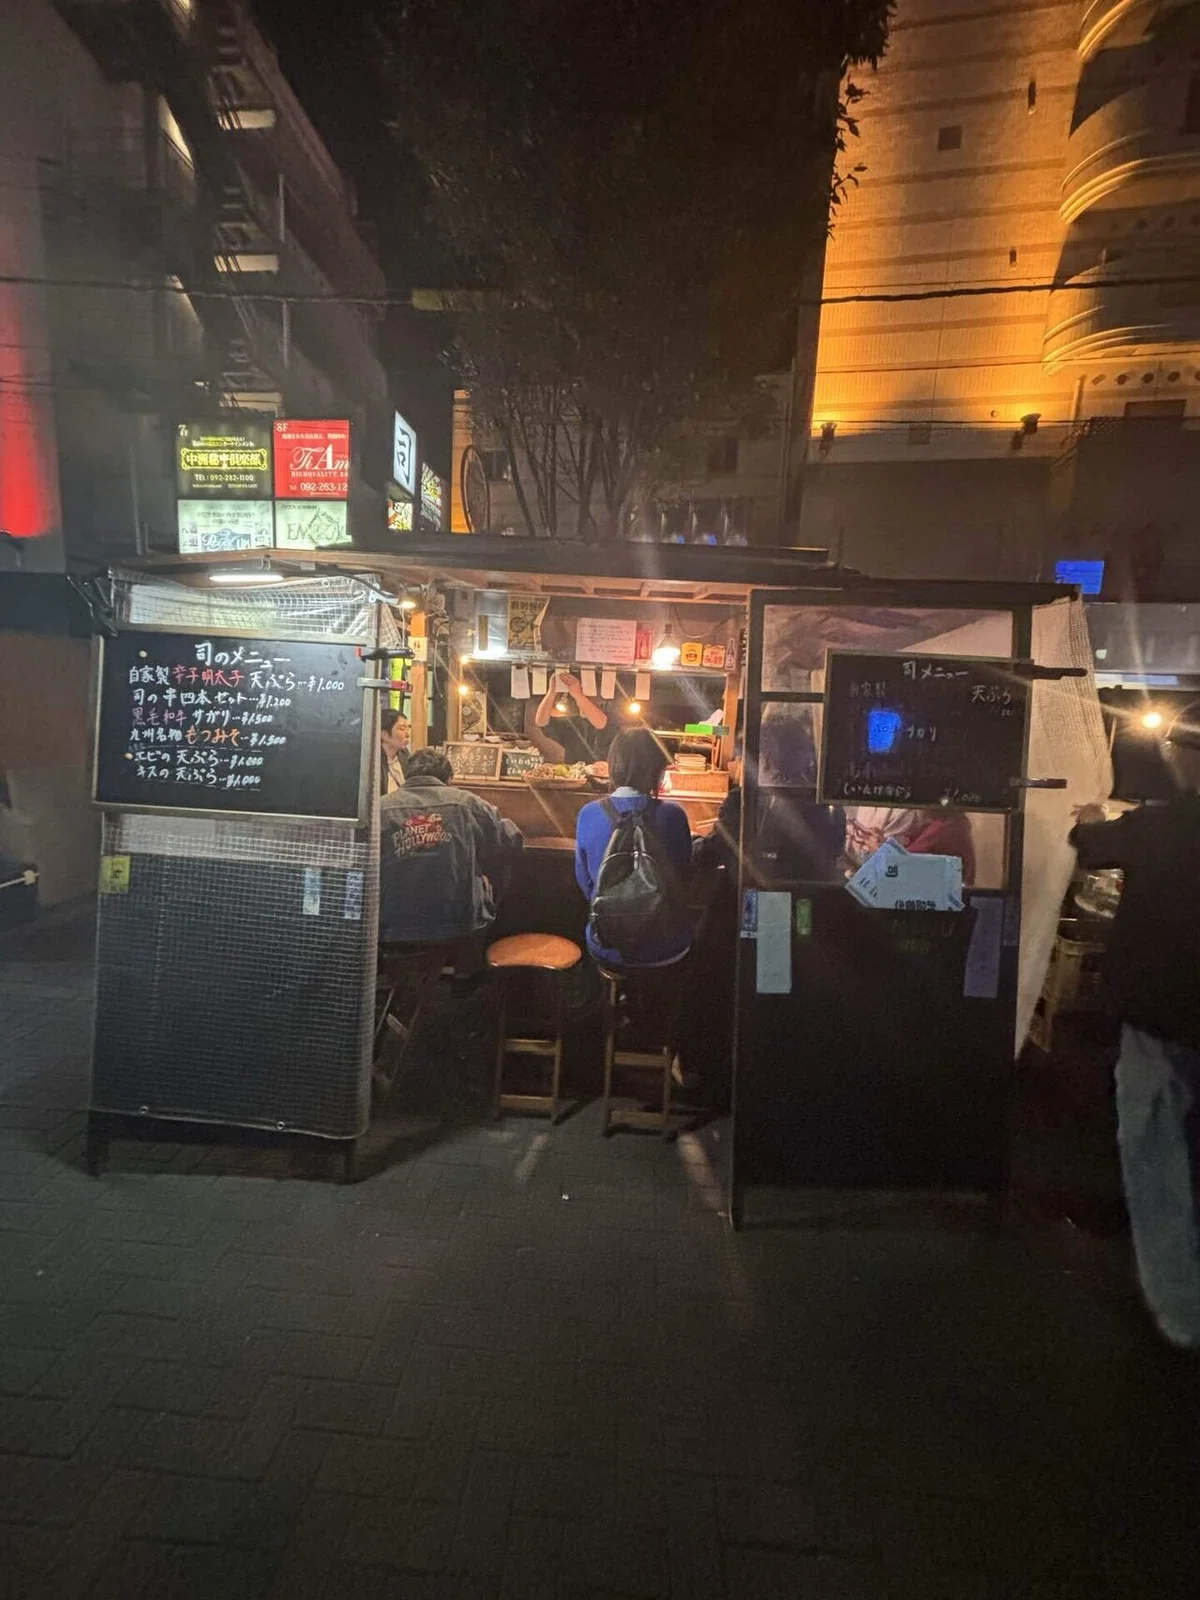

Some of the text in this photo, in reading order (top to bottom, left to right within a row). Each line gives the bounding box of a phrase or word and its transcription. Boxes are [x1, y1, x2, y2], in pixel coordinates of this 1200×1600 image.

[195, 642, 291, 668] 司のメニュー
[391, 823, 432, 848] PLANET
[394, 832, 453, 858] HOLLYWOOD
